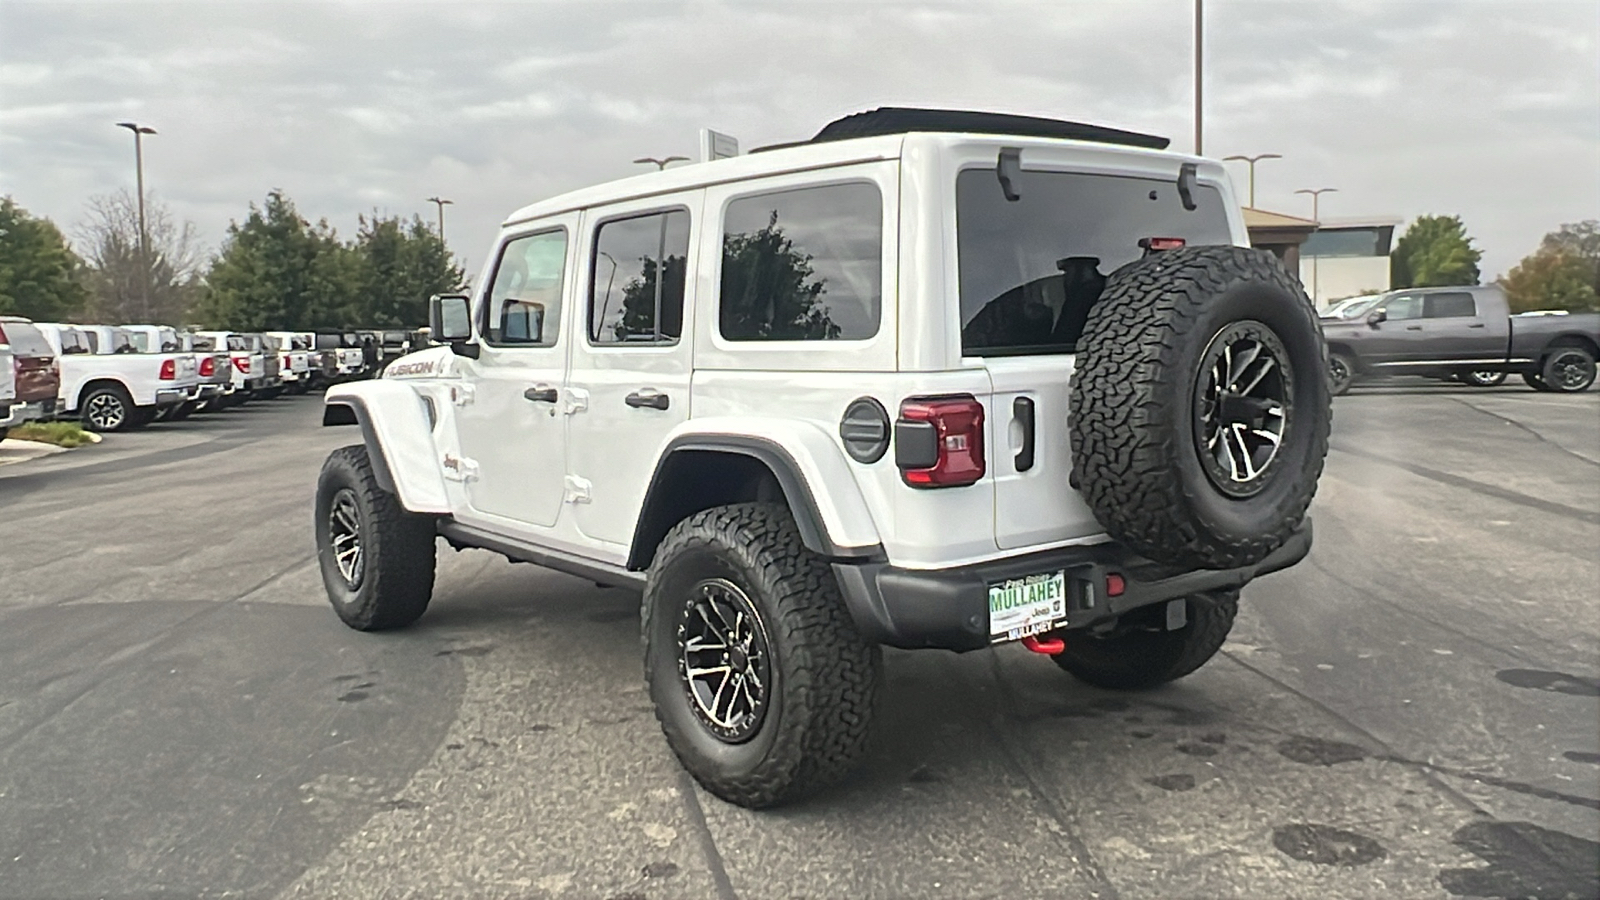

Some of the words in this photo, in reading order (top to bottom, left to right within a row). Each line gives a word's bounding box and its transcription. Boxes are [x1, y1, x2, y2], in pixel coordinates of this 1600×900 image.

[388, 361, 434, 376] RUBICON
[990, 579, 1062, 612] MULLAHEY
[1008, 620, 1053, 640] MULLAHEY
